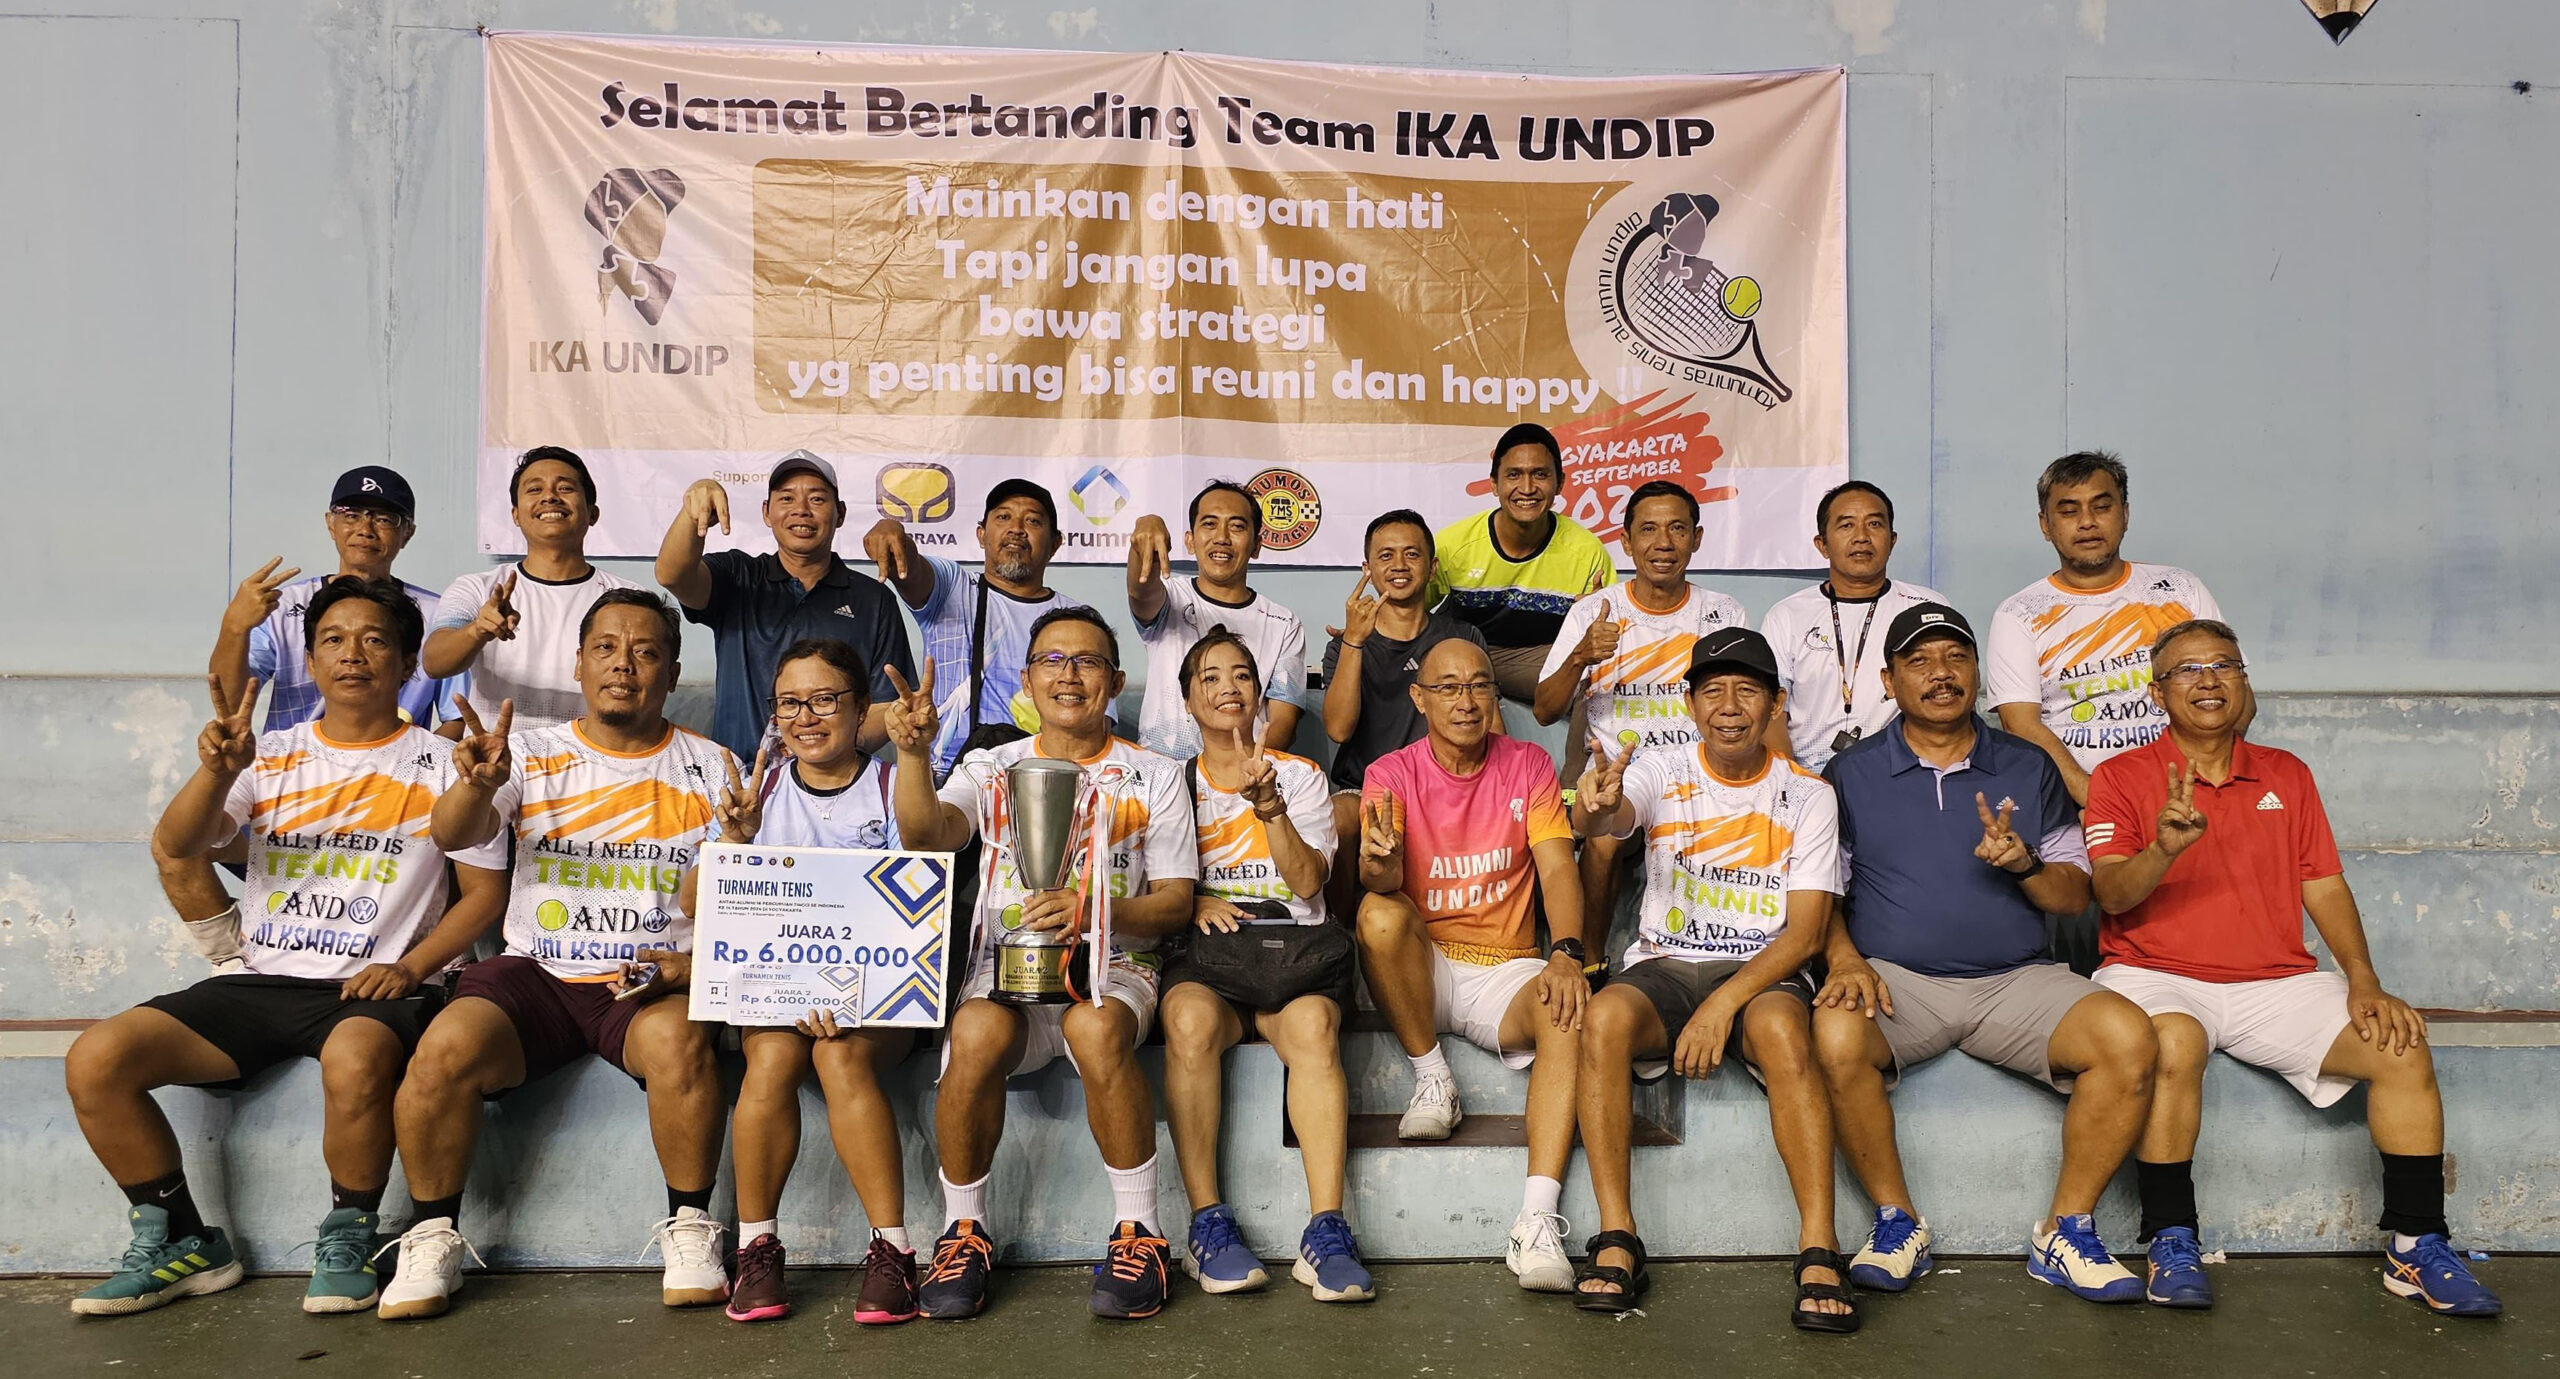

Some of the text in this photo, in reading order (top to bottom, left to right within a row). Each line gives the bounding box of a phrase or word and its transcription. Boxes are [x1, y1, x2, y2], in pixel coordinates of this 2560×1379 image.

[600, 80, 1716, 161] Selamat Bertanding Team IKA UNDIP
[906, 175, 1444, 229] Mainkan dengan hati
[935, 240, 1367, 295] Tapi jangan lupa
[979, 295, 1325, 350] bawa strategi
[529, 341, 729, 376] IKA UNDIP
[788, 360, 852, 399] yg
[869, 353, 1063, 400] penting
[1080, 355, 1176, 395] bisa
[1192, 360, 1315, 399] reuni
[1332, 358, 1426, 401] dan
[1443, 364, 1599, 414] happy
[1561, 432, 1688, 466] GYAKARTA
[1571, 459, 1682, 486] SEPTEMBER
[1271, 505, 1293, 517] YMS
[1261, 523, 1309, 543] ARAGE
[2059, 649, 2152, 681] ALL I NEE
[1613, 681, 1688, 696] ALL I NEE
[2060, 666, 2153, 700] TENN
[1613, 698, 1689, 719] TENN
[2098, 700, 2148, 720] AND
[1643, 730, 1690, 747] AND
[2063, 723, 2168, 749] VOLKSWAG
[266, 830, 307, 849] ALL
[384, 839, 403, 855] IS
[534, 835, 689, 864] ALL I NEED IS
[1113, 853, 1129, 869] IS
[1214, 863, 1267, 880] NEED
[1429, 847, 1512, 880] ALUMNI
[1673, 851, 1781, 891] ALL I NEED IS
[533, 857, 681, 895] TENNIS
[718, 879, 813, 898] TURNAMEN TENIS
[282, 892, 345, 921] AND
[1427, 880, 1508, 912] UNDIP
[1672, 868, 1780, 918] TENNIS
[570, 906, 640, 933] AND
[777, 923, 852, 941] JUARA 2
[1685, 918, 1739, 942] AND
[714, 940, 909, 968] Rp 6.000.000
[741, 994, 759, 1005] Rp
[764, 996, 840, 1007] 6.000.000
